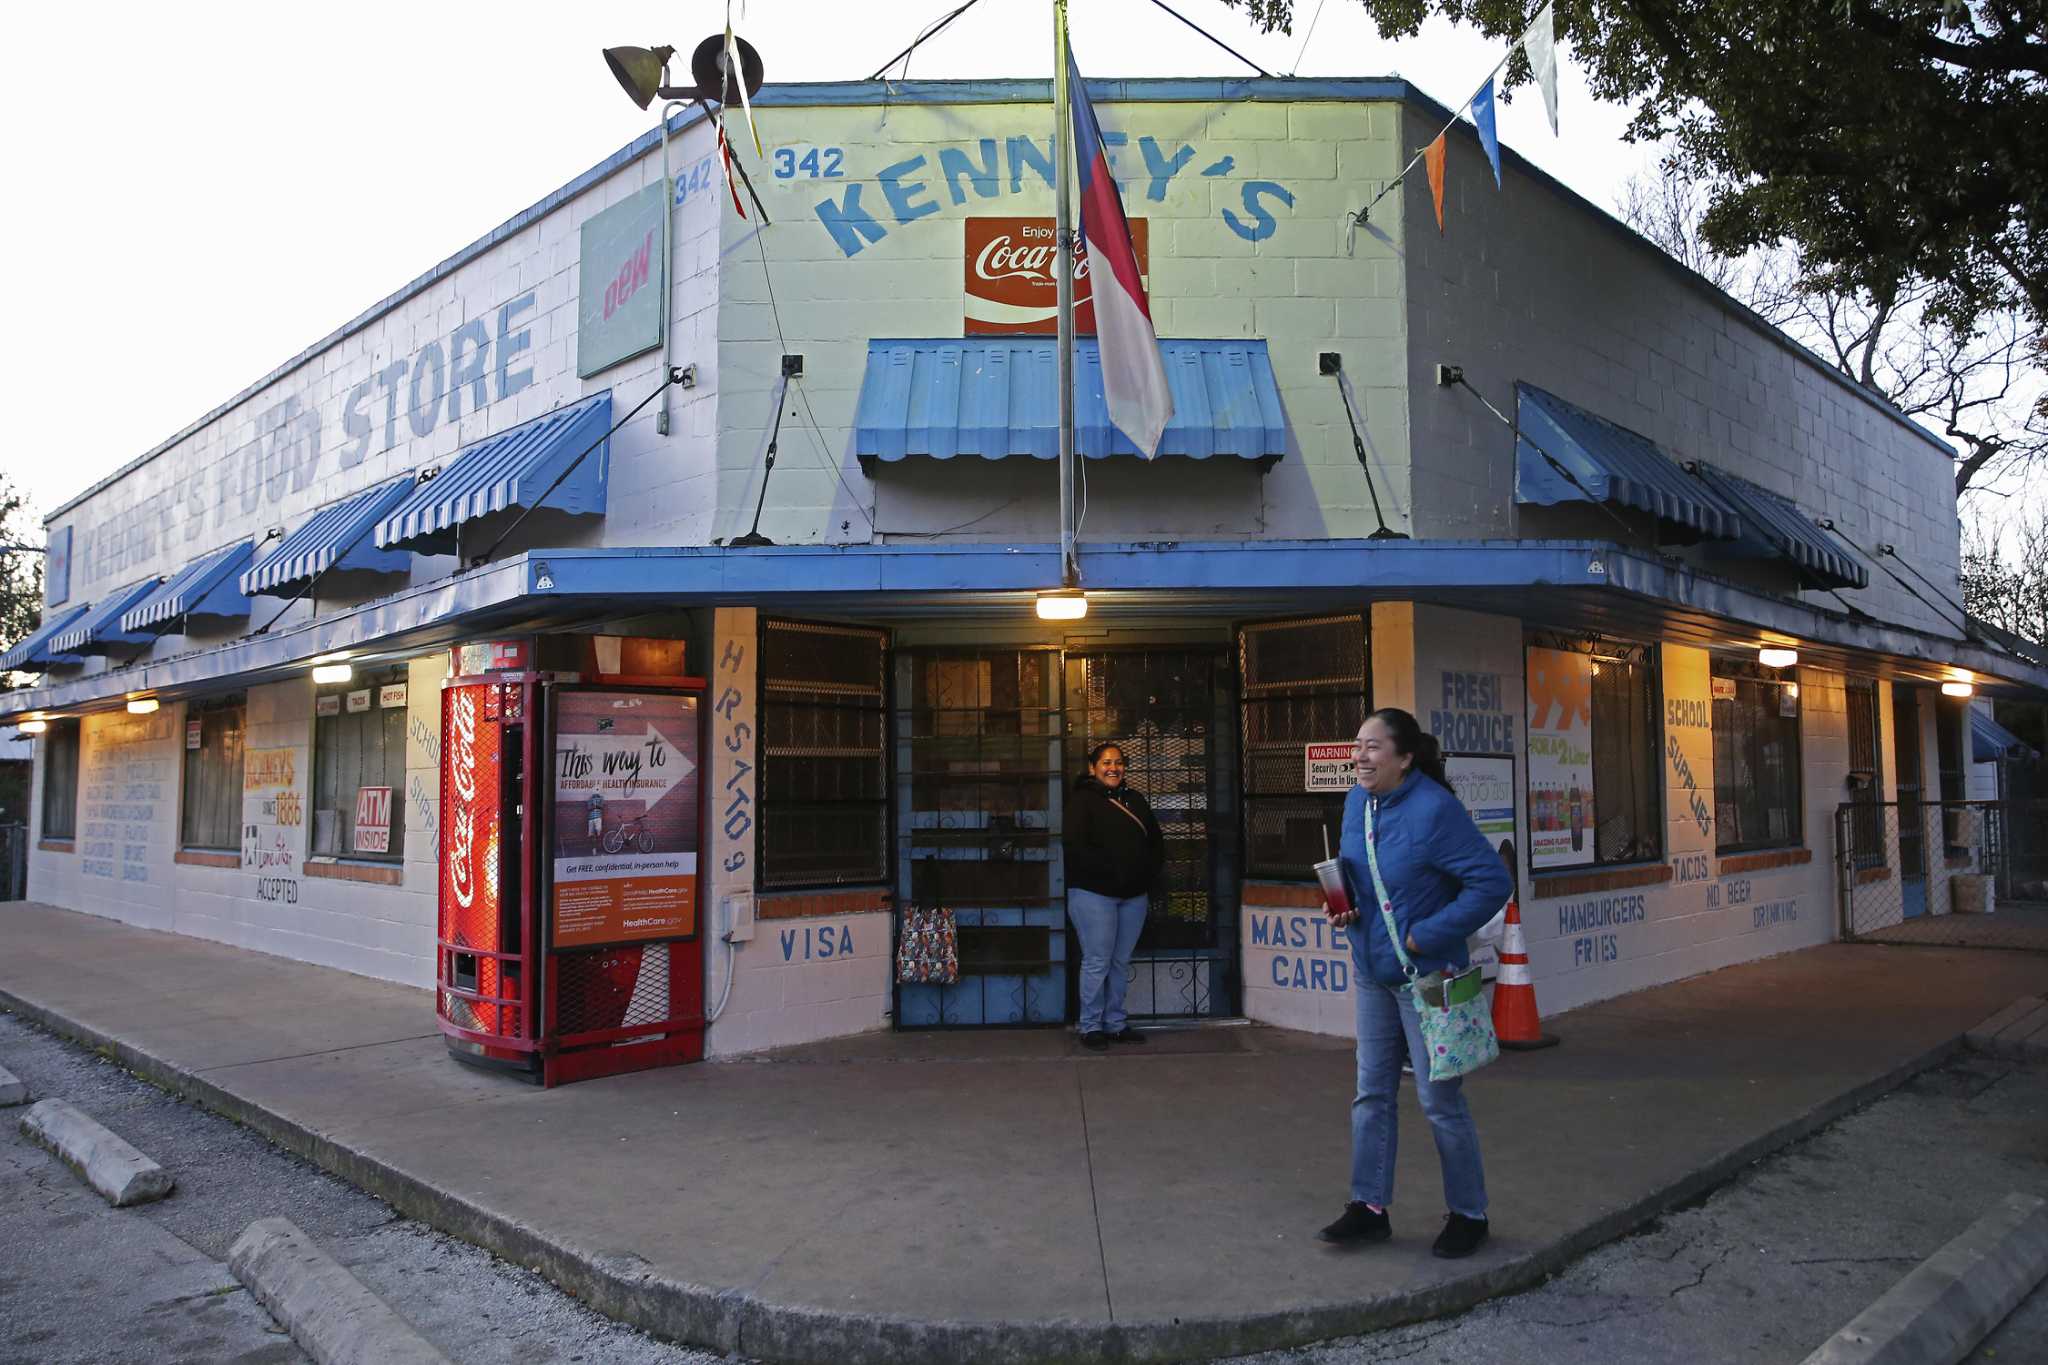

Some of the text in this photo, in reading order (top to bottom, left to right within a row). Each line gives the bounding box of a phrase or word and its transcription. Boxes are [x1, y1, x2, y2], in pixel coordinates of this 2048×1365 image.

[774, 147, 844, 179] 342
[675, 158, 711, 204] 342
[1022, 226, 1054, 239] Enjoy
[975, 235, 1089, 280] Coca-o
[339, 292, 535, 469] STORE
[1441, 671, 1504, 712] FRESH
[1667, 698, 1710, 728] SCHOOL
[1431, 710, 1514, 752] PRODUCE
[557, 735, 666, 798] This way to
[1311, 746, 1351, 758] WARNIN
[1311, 762, 1337, 774] Security
[602, 778, 627, 789] HEALTH
[629, 778, 667, 789] INSURANCE
[1311, 775, 1337, 785] Cameras
[1346, 775, 1358, 785] Use
[1667, 735, 1712, 836] SUPPLIES
[357, 789, 391, 826] ATM
[410, 775, 440, 864] SUPPL
[355, 829, 388, 850] INSIDE
[566, 865, 577, 874] Get
[634, 862, 664, 871] in-person
[665, 860, 679, 869] help
[723, 850, 746, 873] 9
[1673, 855, 1708, 883] TACOS
[256, 877, 299, 904] ACCEPTED
[1706, 879, 1751, 908] NO BEER
[1559, 894, 1645, 935] HAMBURGERS
[1753, 901, 1798, 929] DRINKING
[780, 925, 854, 962] VISA
[1251, 913, 1348, 950] MASTE
[1574, 935, 1617, 967] FRIES
[1271, 955, 1348, 993] CARD
